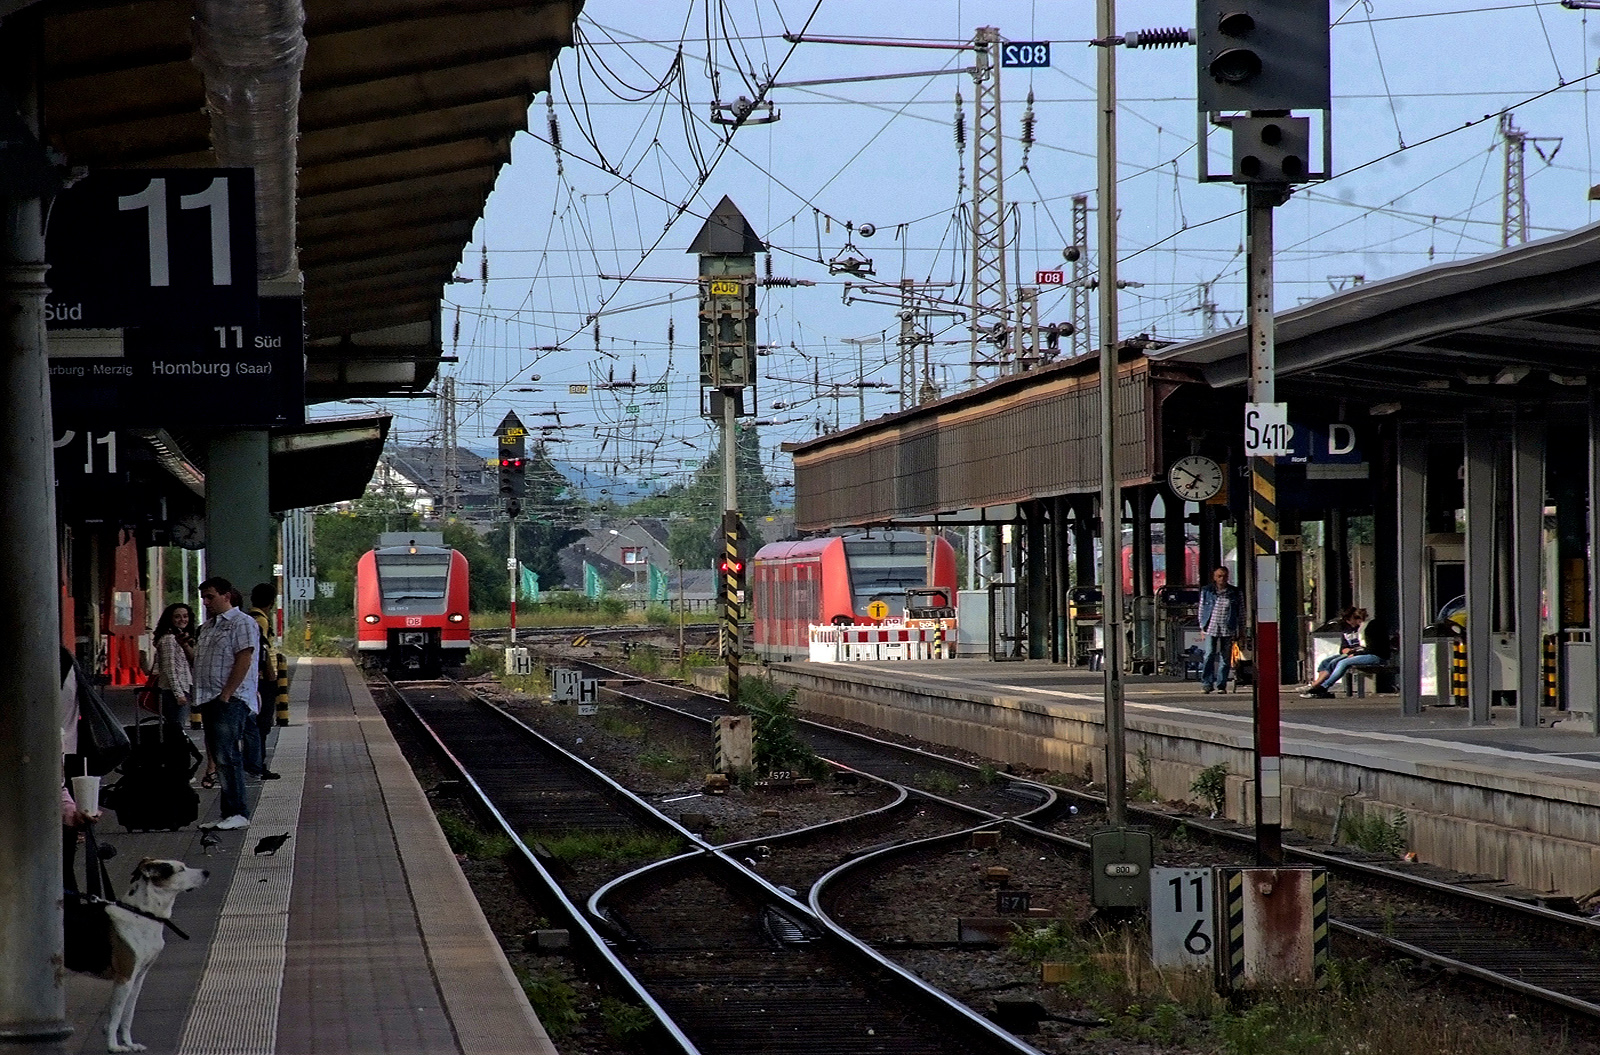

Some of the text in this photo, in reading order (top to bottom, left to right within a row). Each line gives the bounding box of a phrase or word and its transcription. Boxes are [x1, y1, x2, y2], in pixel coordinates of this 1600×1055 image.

[118, 177, 232, 287] 11
[44, 302, 82, 321] Süd
[213, 326, 282, 349] 11 Süd
[48, 363, 133, 377] arburg Merzig
[152, 361, 272, 376] Homburg (Saar)
[1328, 423, 1356, 455] D
[300, 589, 306, 598] 2
[407, 617, 421, 626] DB
[517, 657, 530, 674] H
[561, 672, 578, 684] 111
[566, 685, 574, 696] 4
[580, 680, 596, 702] H
[773, 771, 791, 780] 572
[1168, 876, 1205, 913] 11
[1183, 919, 1212, 955] 6
